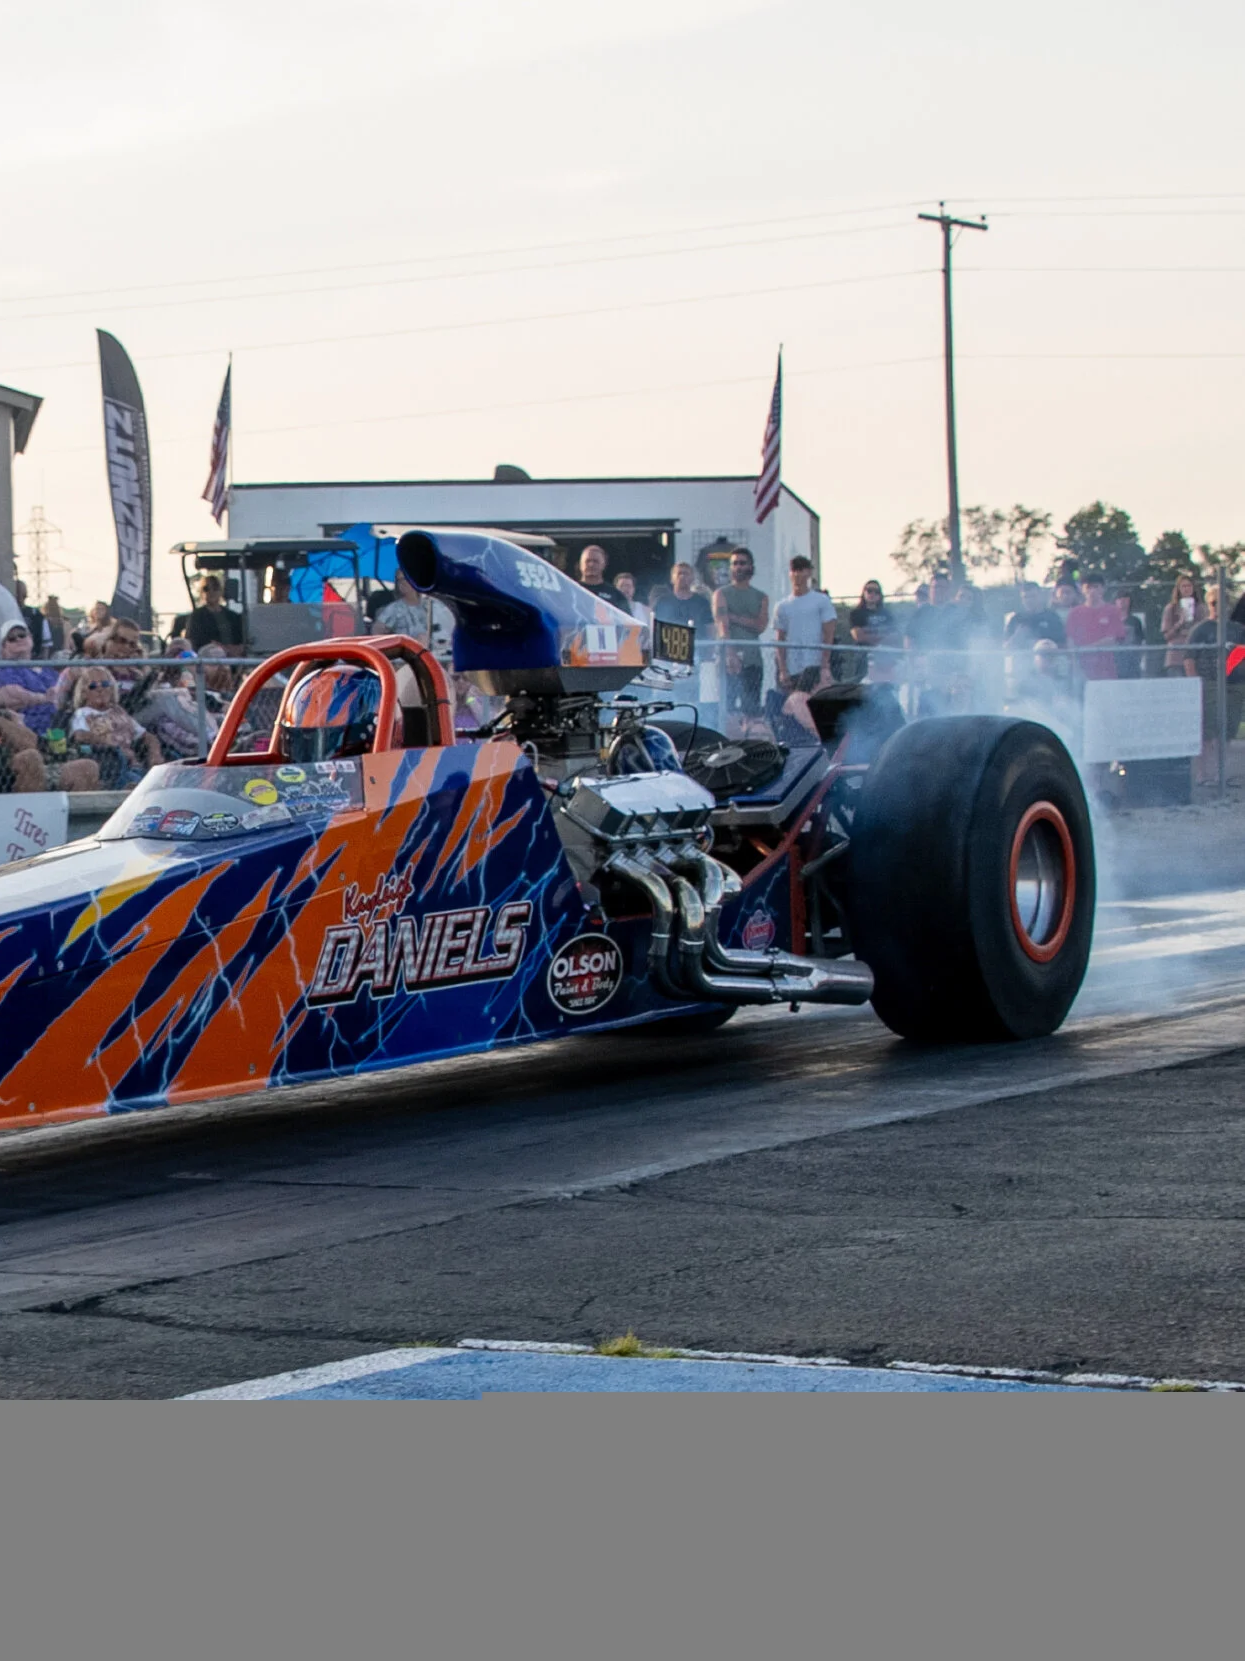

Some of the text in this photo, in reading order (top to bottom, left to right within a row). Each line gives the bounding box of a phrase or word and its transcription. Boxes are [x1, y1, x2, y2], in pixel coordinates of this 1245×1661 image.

[14, 808, 50, 848] Tires
[306, 900, 533, 1009] DANIELS
[552, 949, 617, 979] OLSON
